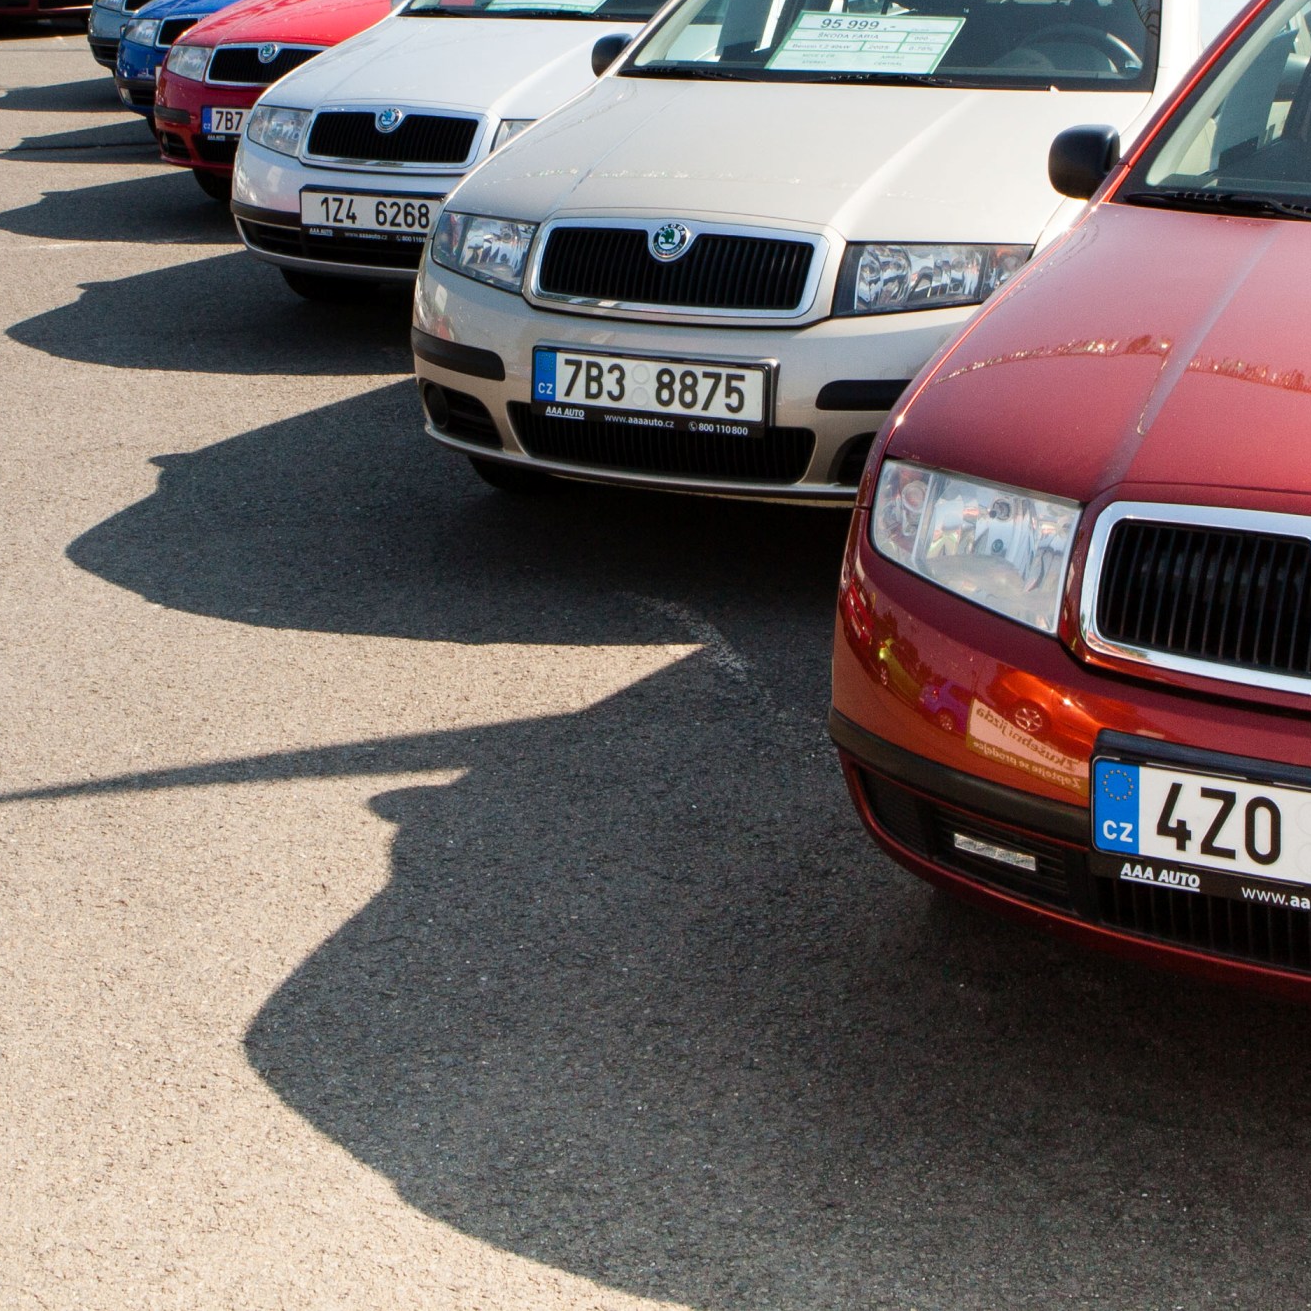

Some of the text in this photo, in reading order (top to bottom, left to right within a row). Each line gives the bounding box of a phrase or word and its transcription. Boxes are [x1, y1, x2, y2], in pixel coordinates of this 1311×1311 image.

[820, 18, 841, 29] 95
[846, 19, 880, 30] 999
[215, 110, 243, 131] 7B7
[320, 196, 430, 229] 1Z4 6268
[538, 358, 746, 414] CZ 7B3 8875
[545, 406, 563, 416] AAA
[564, 408, 585, 418] AUTO
[604, 413, 675, 429] www.aaaauto.cz
[698, 423, 714, 433] 800
[1102, 819, 1133, 843] CZ
[1156, 782, 1282, 866] 4Z0
[1121, 863, 1155, 881] AAA
[1158, 869, 1200, 889] AUTO
